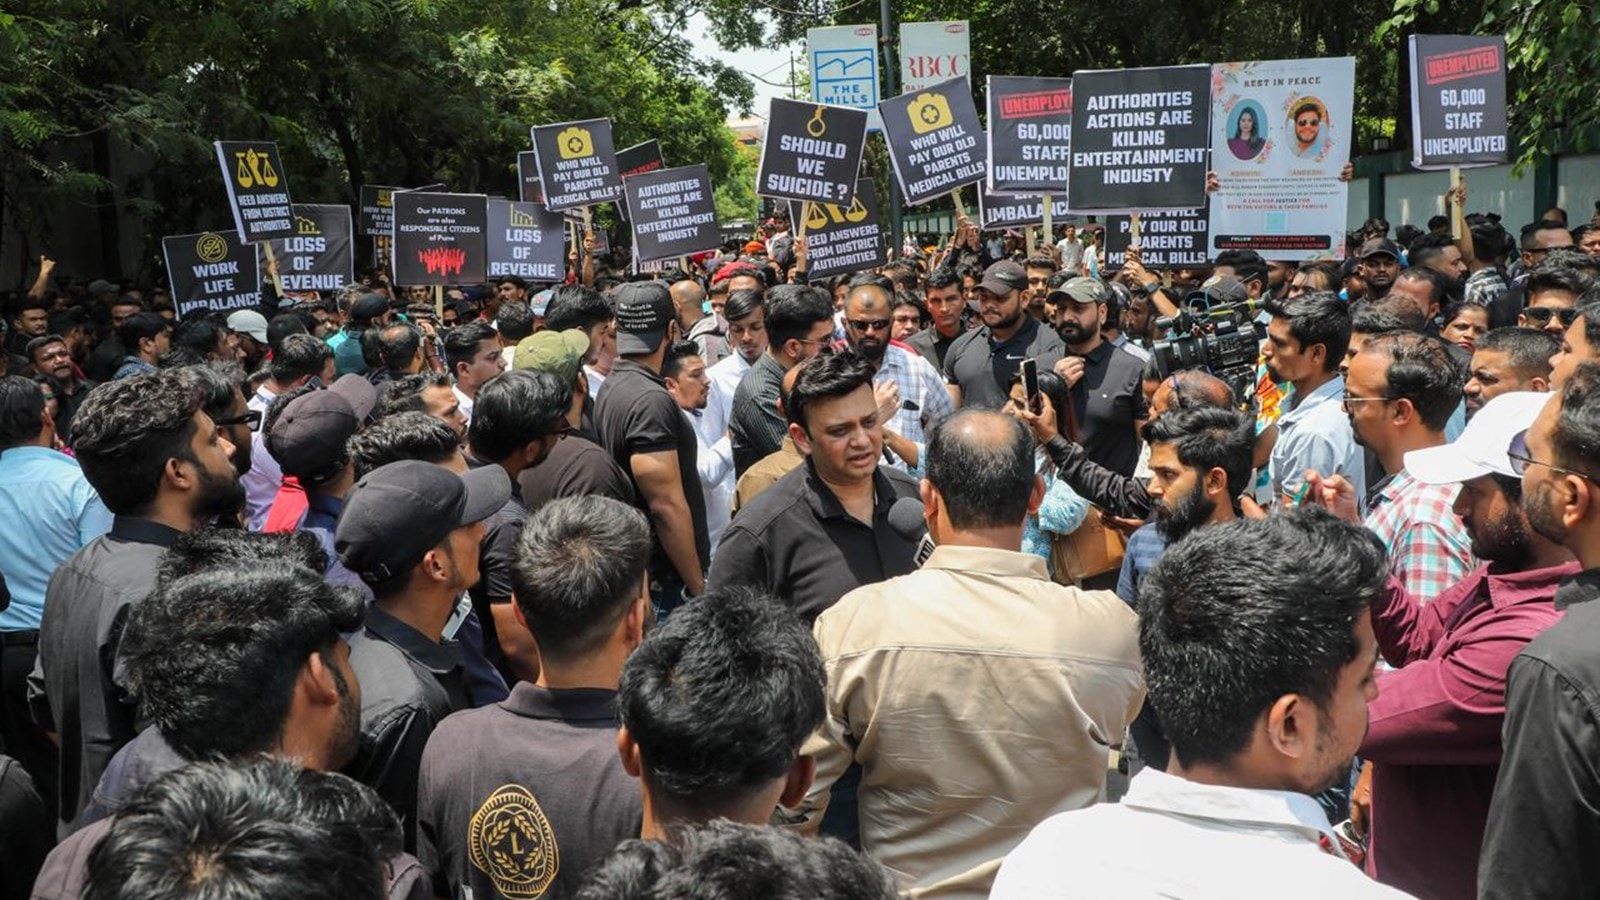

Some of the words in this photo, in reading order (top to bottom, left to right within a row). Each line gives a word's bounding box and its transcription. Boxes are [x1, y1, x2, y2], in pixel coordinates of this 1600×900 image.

[1428, 51, 1496, 78] UNEMPLOYED
[832, 84, 860, 94] THE
[1244, 79, 1269, 88] REST
[1288, 76, 1321, 86] PEACE
[824, 94, 867, 104] MILLS
[1003, 94, 1070, 114] UNEMPLOY
[1087, 91, 1193, 112] AUTHORITIES
[1441, 88, 1486, 109] 60,000
[1087, 112, 1156, 130] ACTIONS
[1159, 110, 1193, 125] ARE
[1444, 112, 1483, 130] STAFF
[910, 132, 938, 151] WHO
[938, 123, 966, 142] WILL
[1018, 123, 1071, 142] 60,000
[1112, 130, 1165, 147] KILING
[780, 134, 847, 159] SHOULD
[908, 149, 930, 166] PAY
[932, 142, 955, 159] OUR
[954, 136, 976, 151] OLD
[1022, 145, 1070, 161] STAFF
[1423, 135, 1506, 157] UNEMPLOYED
[555, 160, 581, 172] WHO
[580, 156, 604, 167] WILL
[923, 152, 971, 176] PARENTS
[1073, 148, 1205, 168] ENTERTAINMENT
[553, 172, 573, 183] PAY
[572, 169, 592, 181] OUR
[591, 165, 611, 177] OLD
[797, 157, 826, 177] WE
[995, 165, 1067, 181] UNEMPLO
[564, 177, 604, 193] PARENTS
[908, 171, 957, 196] MEDICAL
[955, 160, 985, 180] BILLS
[1103, 168, 1174, 185] INDUSTY
[637, 178, 701, 198] AUTHORITIES
[767, 173, 834, 198] SUICIDE
[837, 183, 848, 200] ?
[238, 194, 257, 206] NEED
[256, 193, 288, 205] ANSWERS
[549, 192, 589, 207] MEDICAL
[589, 188, 614, 200] BILLS
[614, 187, 622, 197] ?
[640, 195, 682, 211] ACTIONS
[682, 191, 703, 203] ARE
[242, 207, 263, 220] FROM
[261, 206, 290, 219] DISTRICT
[416, 207, 431, 215] Our
[657, 205, 690, 219] KILING
[250, 218, 291, 233] AUTHORITIES
[400, 225, 448, 233] RESPONSIBLE
[449, 225, 480, 233] CITIZENS
[637, 212, 715, 235] ENTERTAINMENT
[1120, 221, 1147, 233] PY
[1150, 220, 1177, 232] OUR
[1180, 219, 1207, 232] OLD
[506, 229, 542, 244] LOSS
[657, 227, 699, 243] INDUSTY
[807, 232, 828, 247] EED
[829, 224, 879, 242] ANSWERS
[284, 237, 327, 253] LOSS
[513, 247, 531, 260] OF
[806, 244, 835, 260] FROM
[835, 236, 879, 255] DISTRICT
[293, 256, 314, 271] OF
[813, 250, 877, 272] AUTHORITIES
[1169, 252, 1206, 264] BILLS
[192, 261, 240, 278] WORK
[491, 261, 556, 277] REVENUE
[203, 279, 235, 295] LIFE
[281, 274, 344, 290] EVENUE
[510, 831, 525, 855] L
